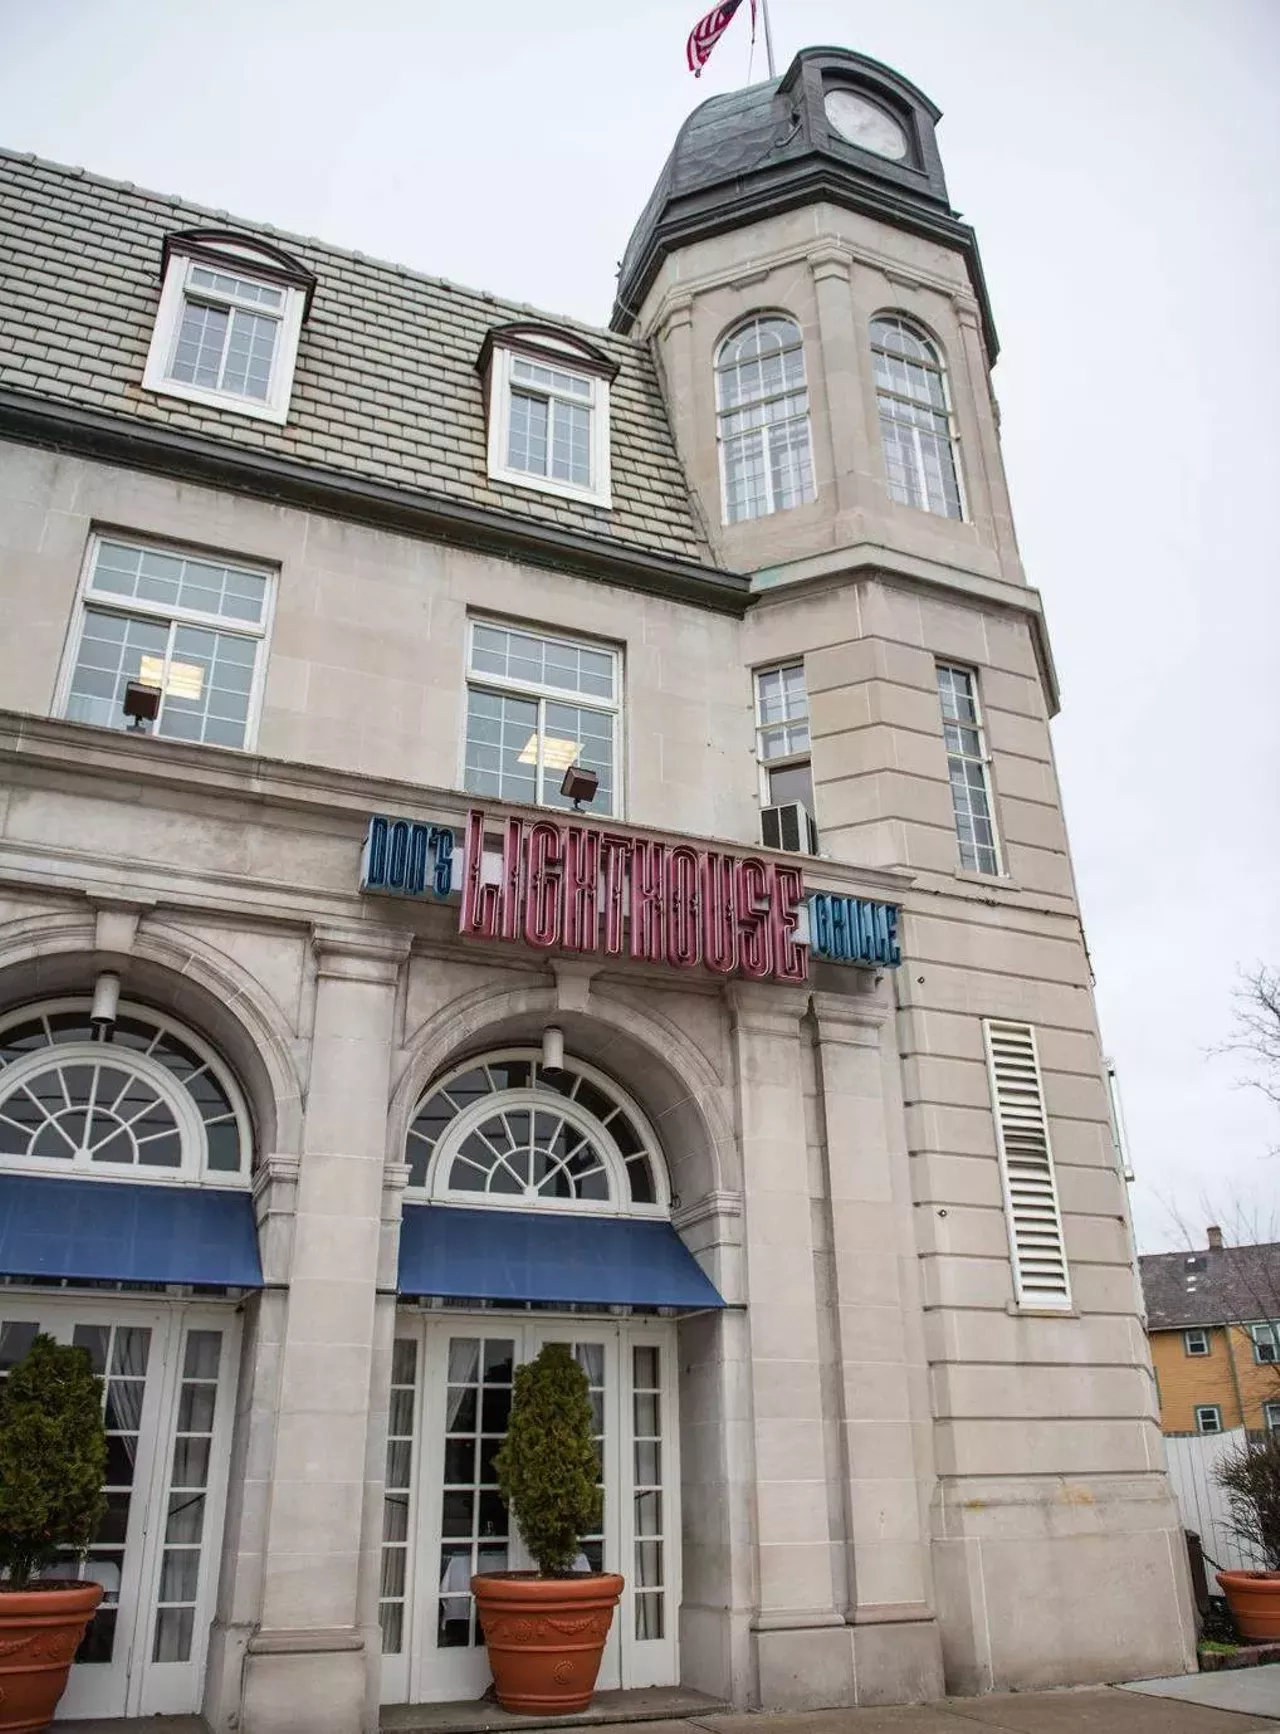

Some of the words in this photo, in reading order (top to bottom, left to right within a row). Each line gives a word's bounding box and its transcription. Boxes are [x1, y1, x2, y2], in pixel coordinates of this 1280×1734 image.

[363, 815, 455, 898] DON'S
[459, 808, 808, 983] LIGHTHOUSE
[808, 893, 901, 967] GRILLE
